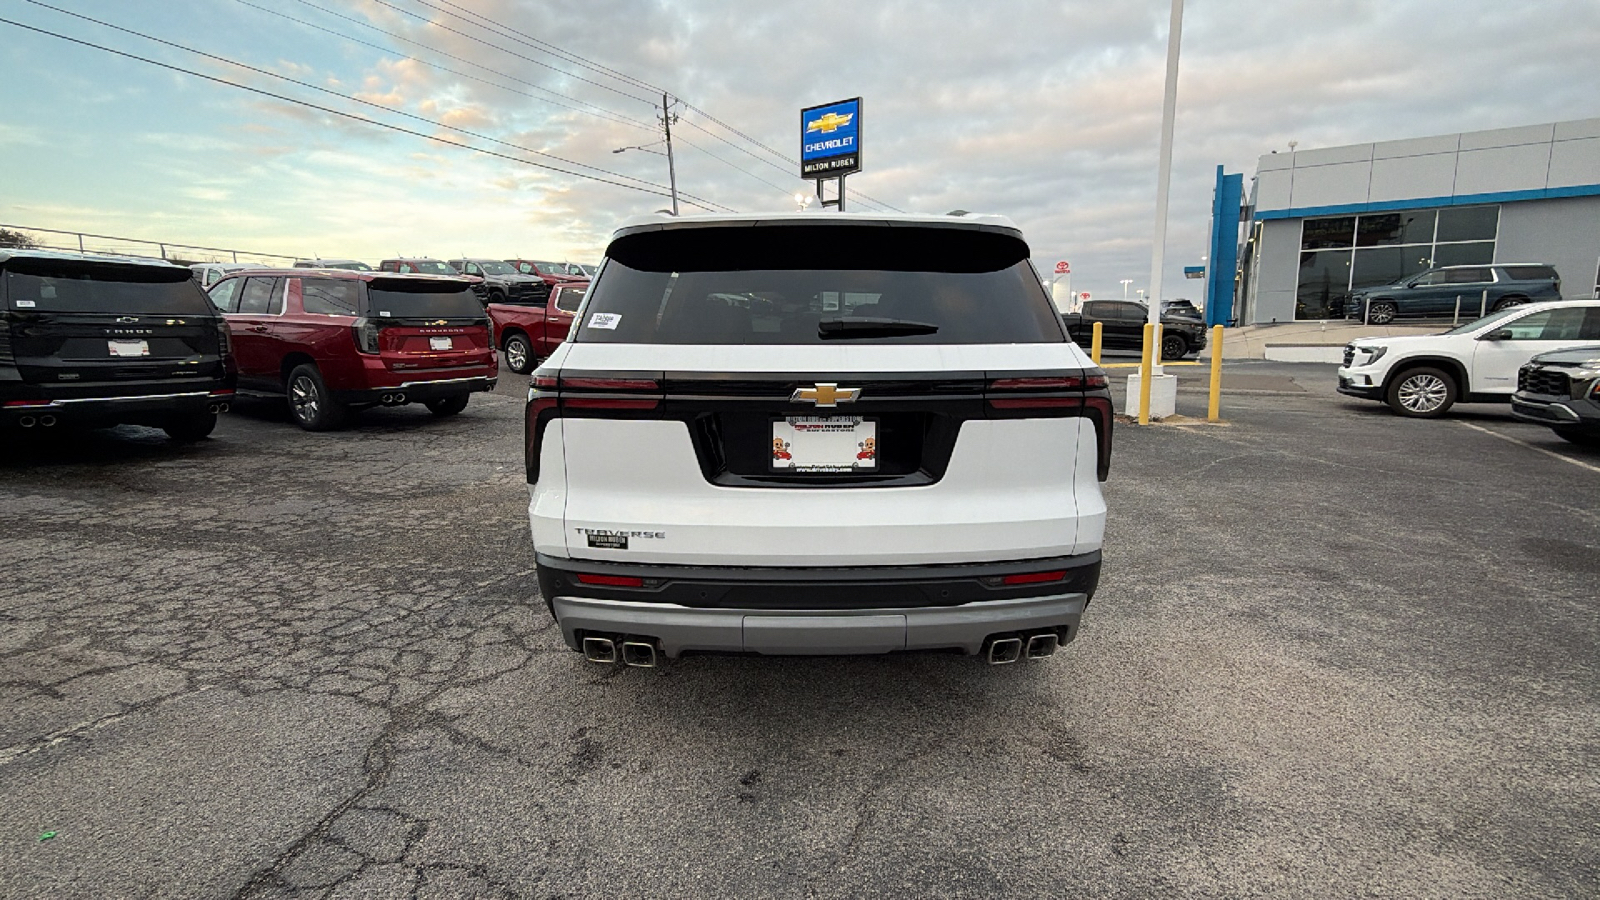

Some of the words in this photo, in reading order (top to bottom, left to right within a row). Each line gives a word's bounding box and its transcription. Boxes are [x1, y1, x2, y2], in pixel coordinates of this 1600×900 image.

[805, 136, 854, 153] CHEVROLET
[804, 162, 829, 173] MILTON
[831, 158, 855, 168] RUBEN
[574, 527, 666, 539] TRAVERSE
